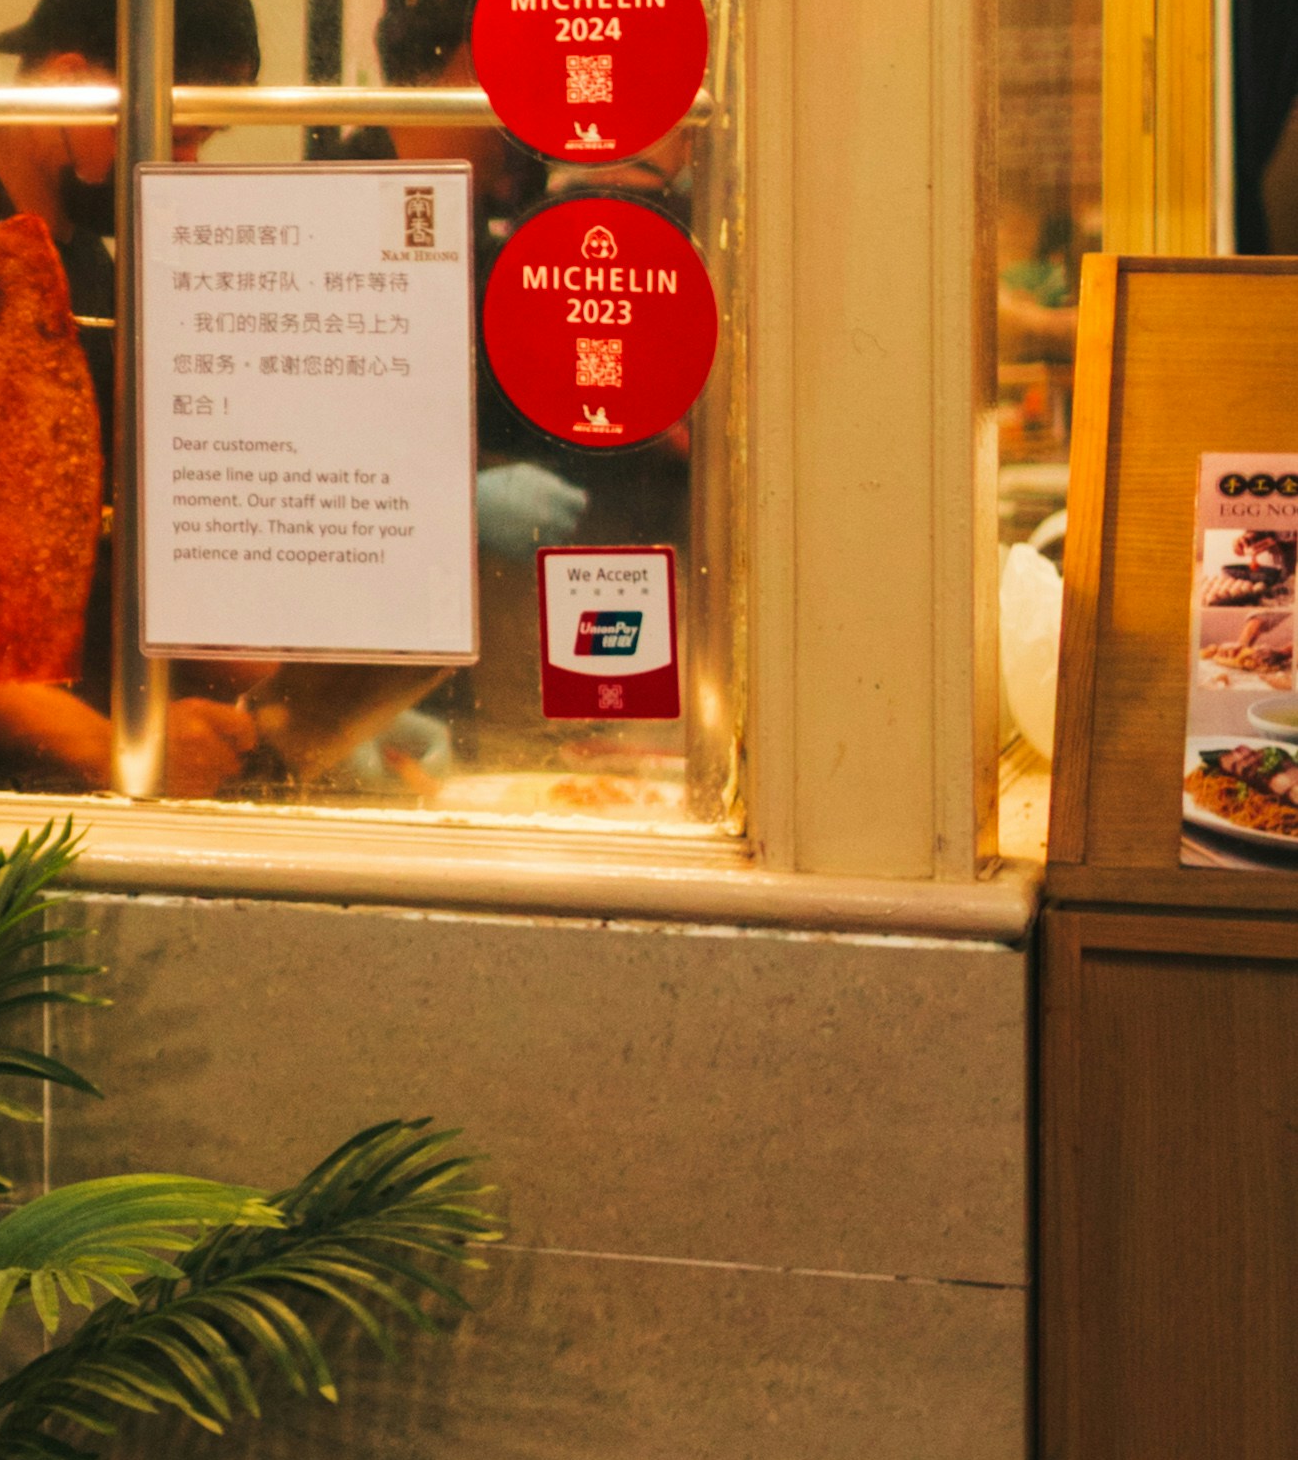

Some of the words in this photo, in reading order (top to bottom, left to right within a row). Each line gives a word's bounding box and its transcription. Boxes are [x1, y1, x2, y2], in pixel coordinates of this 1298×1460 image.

[555, 17, 622, 42] 2024
[522, 265, 677, 295] MICHELIN
[566, 298, 632, 325] 2023
[172, 436, 208, 452] Dear
[213, 438, 298, 454] customers,
[172, 466, 221, 484] please
[226, 466, 254, 482] line
[258, 471, 279, 486] up
[283, 469, 311, 484] and
[316, 470, 349, 485] wait
[353, 469, 376, 485] for
[380, 474, 390, 485] a
[172, 493, 242, 508] moment.
[247, 493, 276, 508] Our
[280, 493, 316, 509] staff
[320, 495, 346, 510] will
[351, 495, 370, 510] be
[375, 496, 409, 511] with
[1220, 504, 1261, 516] EGG
[1268, 503, 1298, 516] NO
[172, 521, 200, 535] you
[205, 518, 262, 537] shortly.
[267, 519, 315, 535] Thank
[319, 523, 348, 538] you
[352, 520, 374, 535] for
[379, 525, 415, 539] your
[172, 546, 239, 563] patience
[243, 547, 272, 562] and
[276, 548, 385, 565] cooperation!
[567, 568, 591, 582] We
[596, 568, 649, 584] Accept
[579, 621, 639, 640] UnionPay
